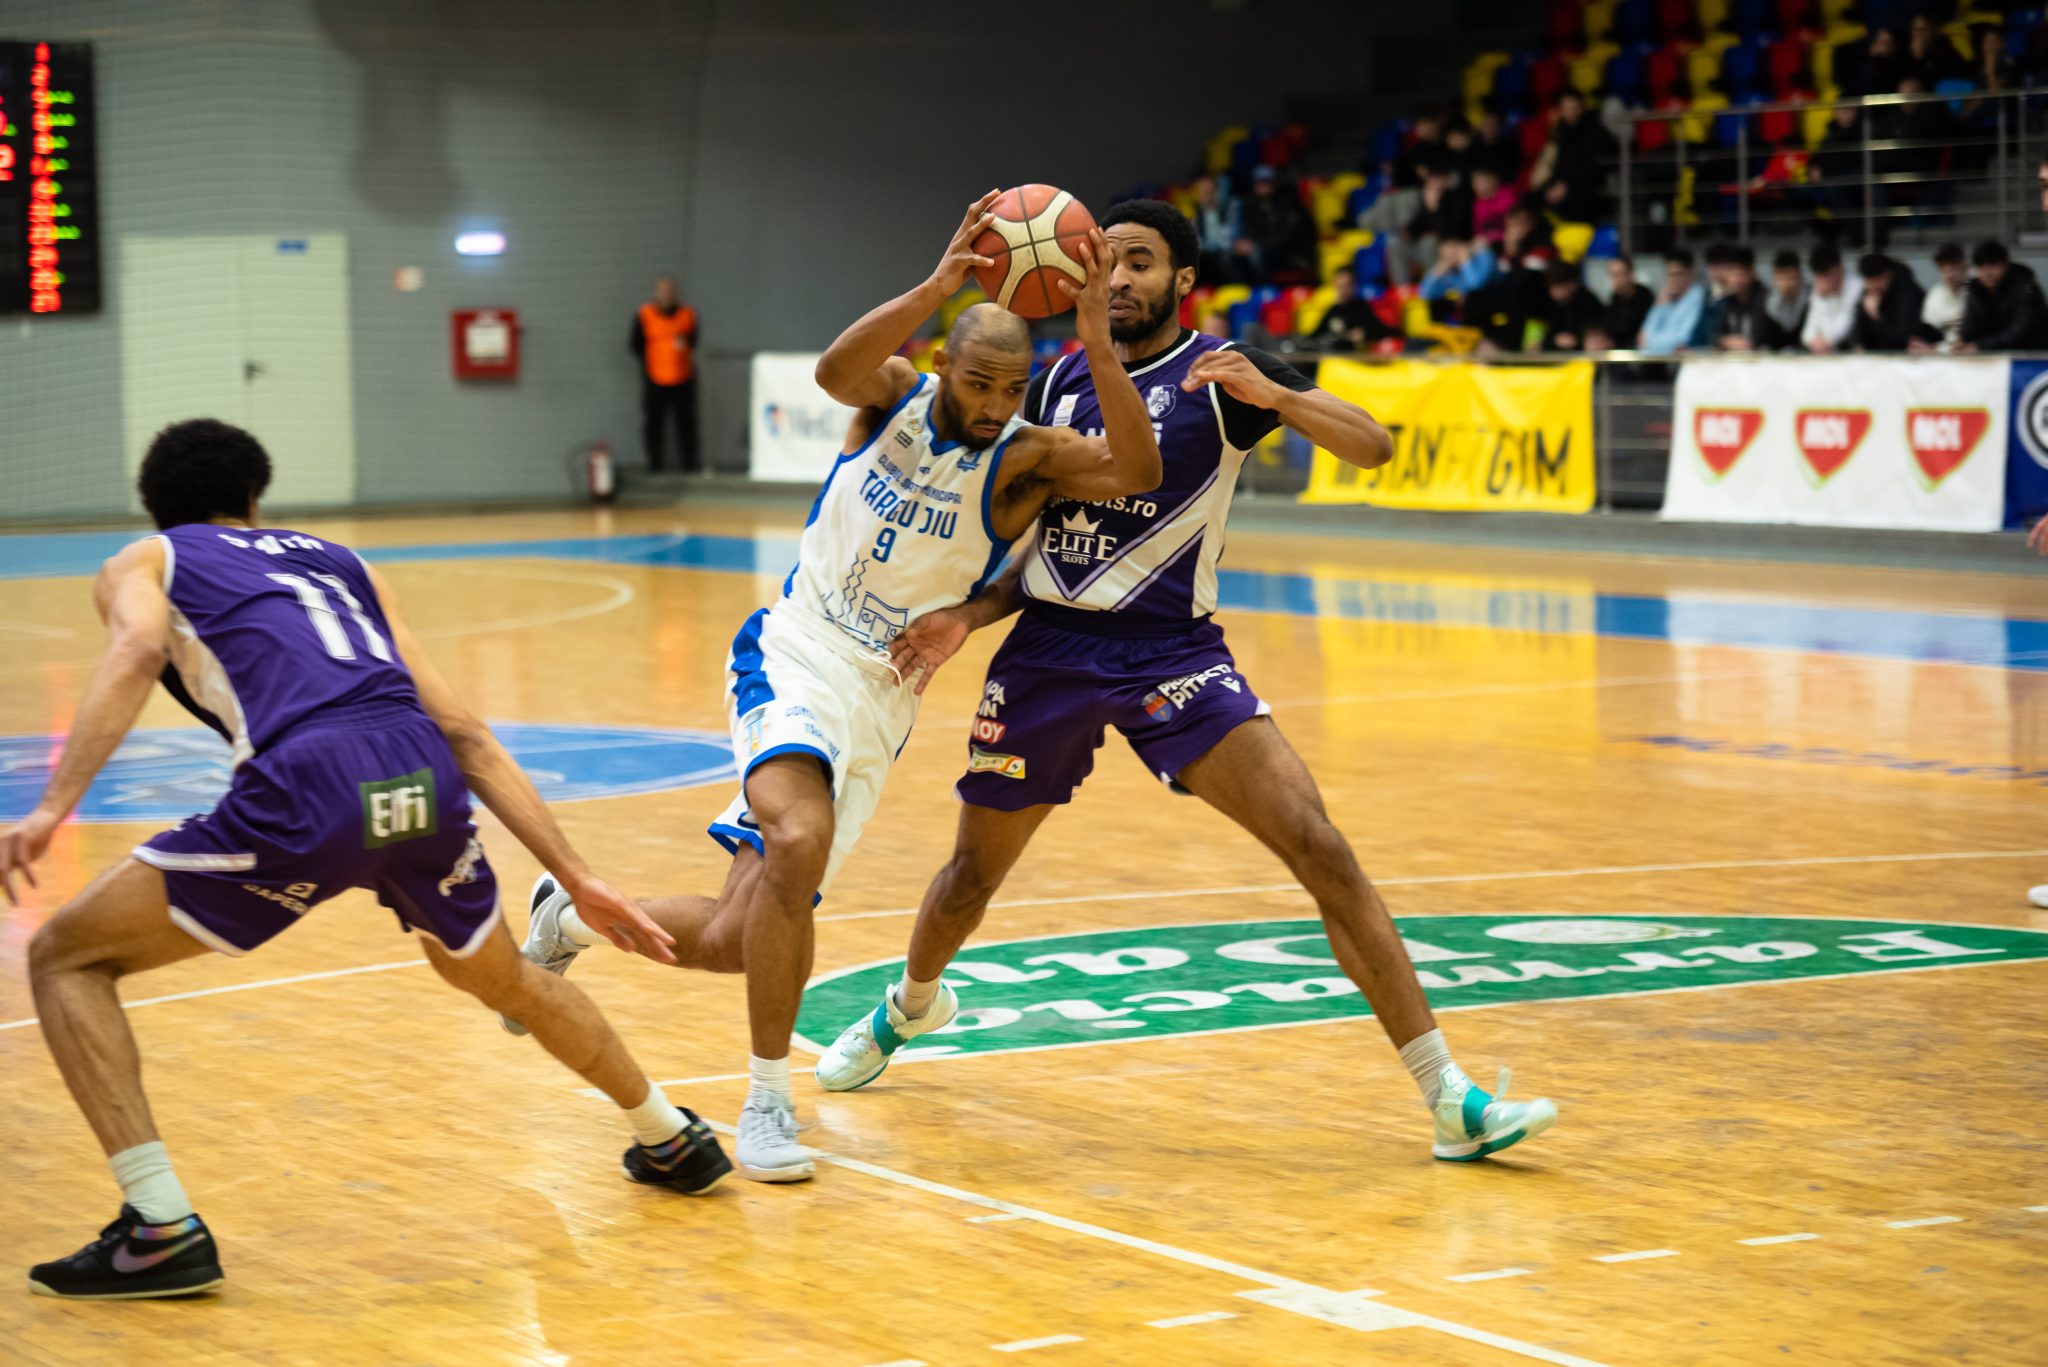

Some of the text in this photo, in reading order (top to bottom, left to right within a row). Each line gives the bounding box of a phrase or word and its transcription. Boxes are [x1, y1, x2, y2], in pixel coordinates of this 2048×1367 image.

[917, 506, 959, 540] JIU
[871, 527, 898, 564] 9
[1041, 526, 1119, 562] ELITE
[1060, 553, 1110, 566] SLOTS
[264, 572, 396, 664] 11
